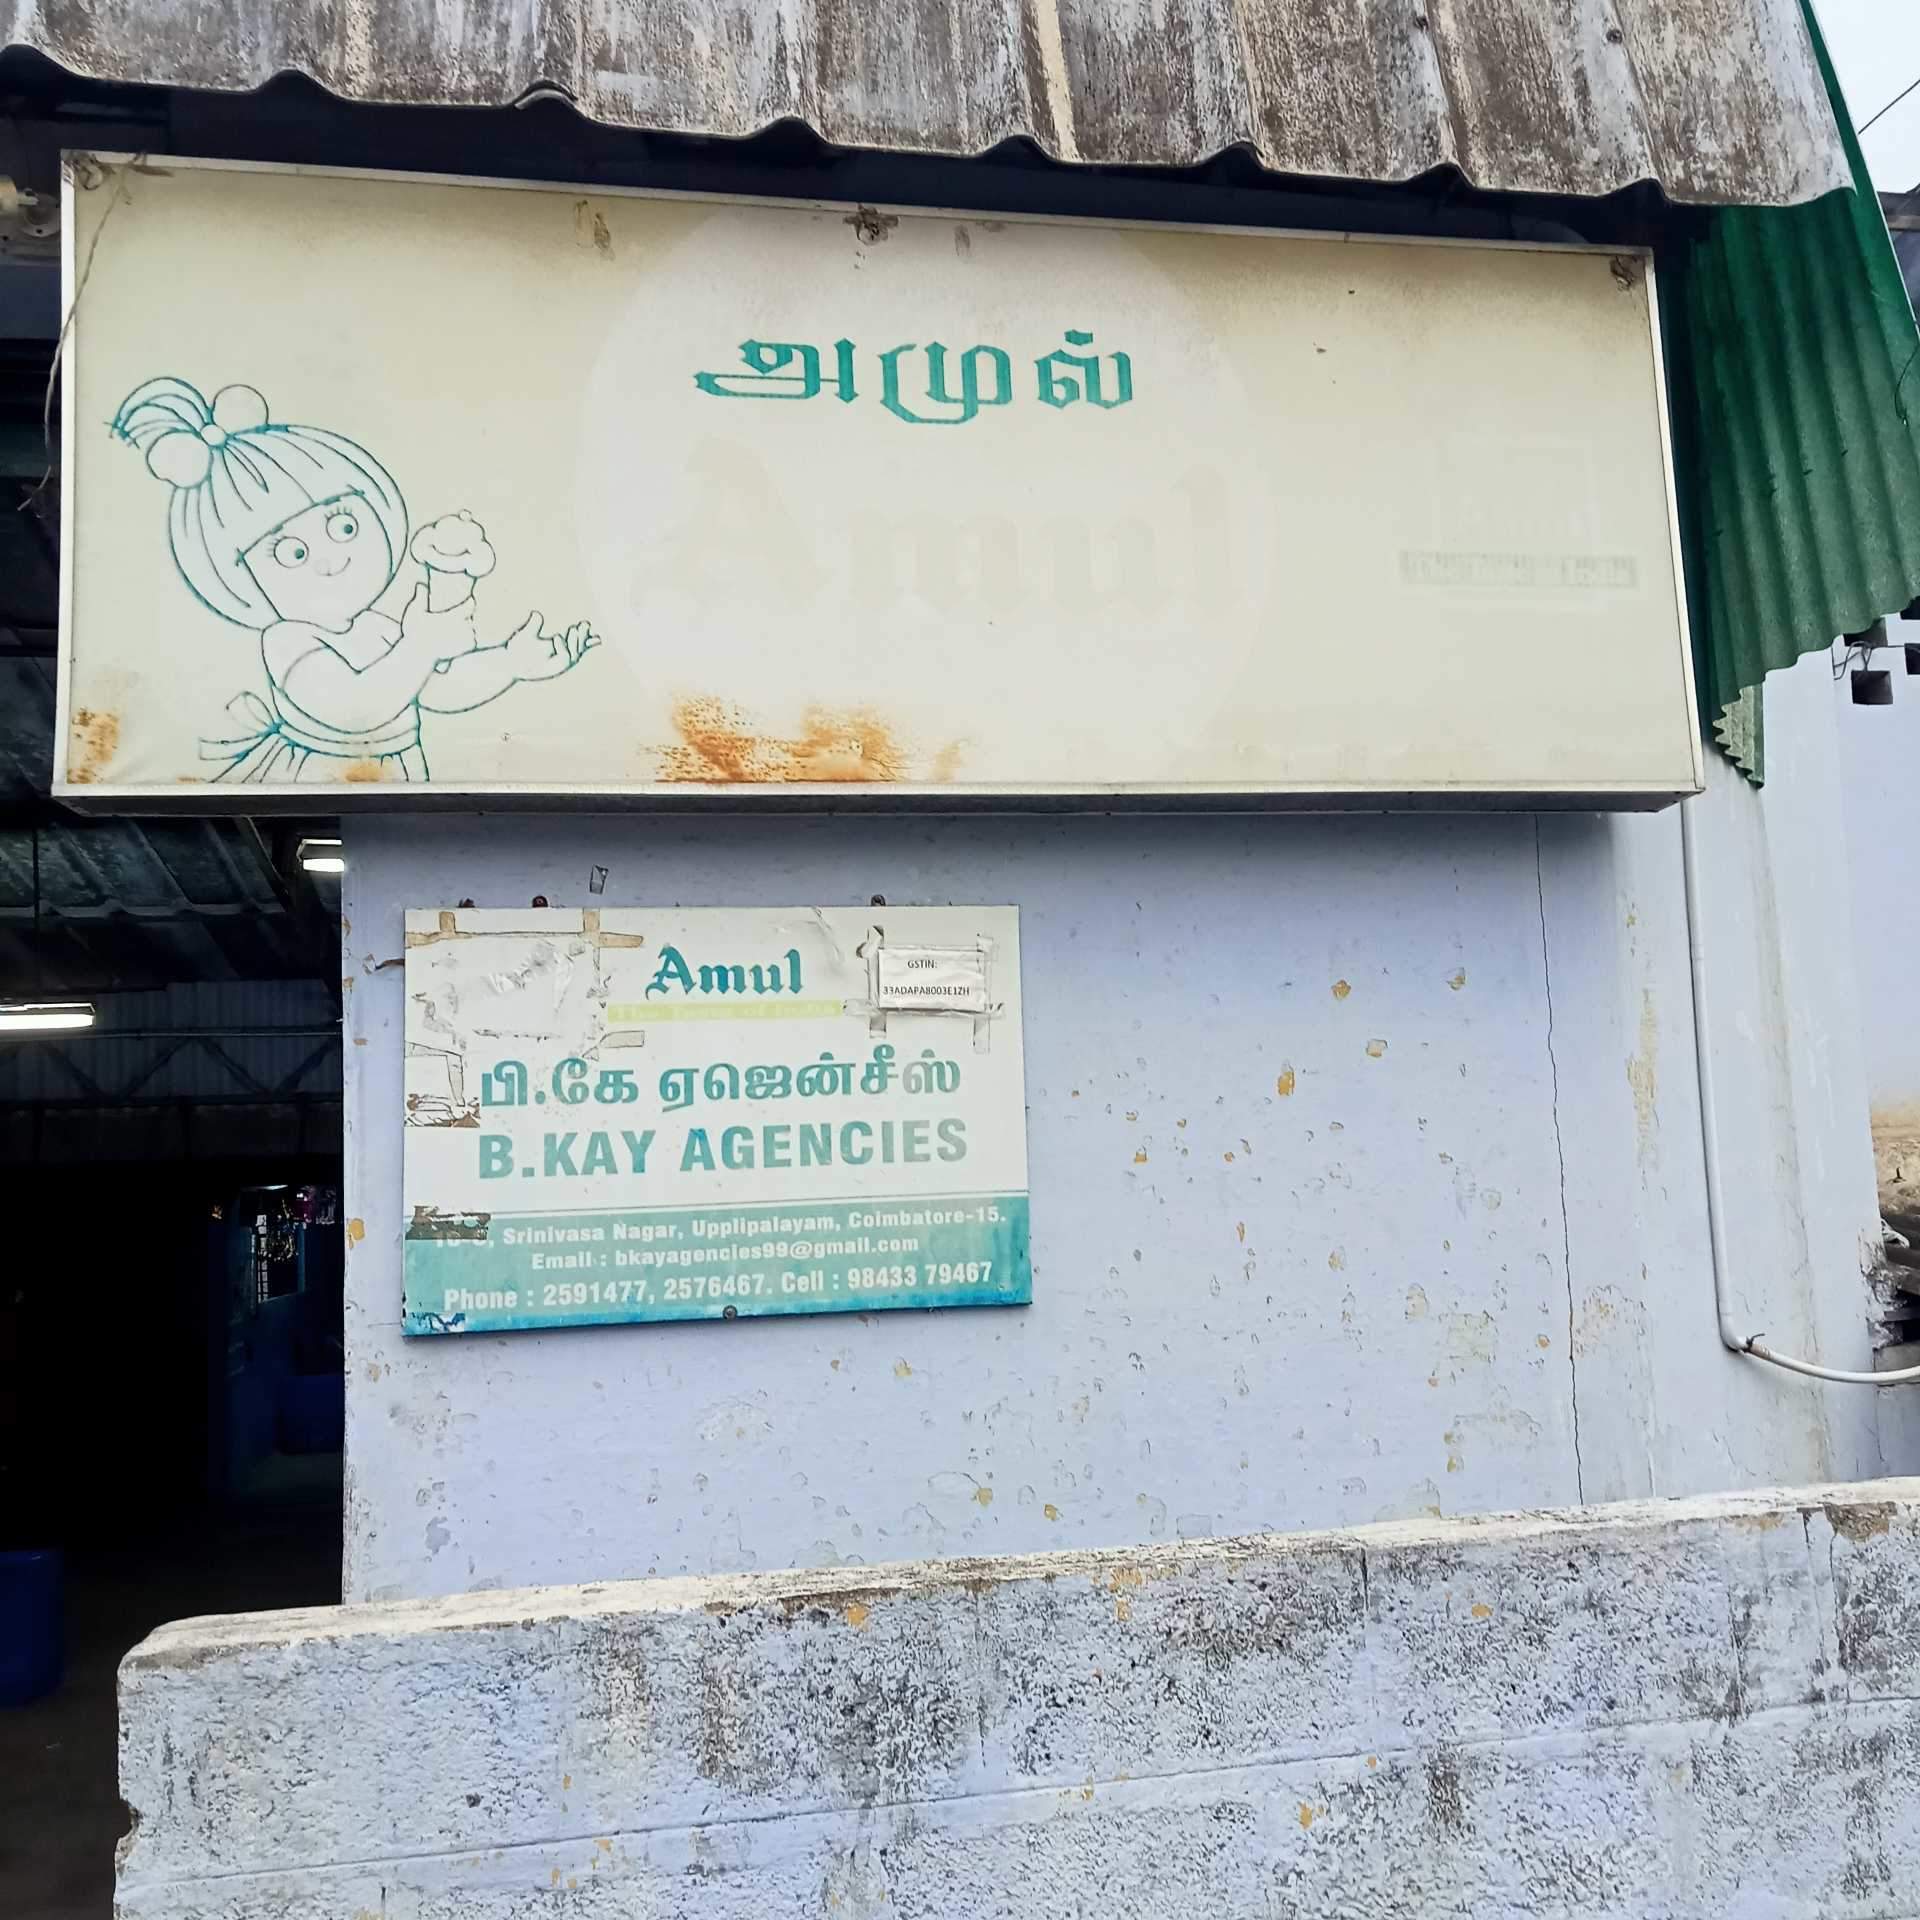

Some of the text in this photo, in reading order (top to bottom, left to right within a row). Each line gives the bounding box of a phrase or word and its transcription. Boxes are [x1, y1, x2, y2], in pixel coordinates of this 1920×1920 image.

[693, 329, 1133, 424] அமுல்
[645, 945, 803, 1000] Amul
[907, 959, 938, 969] GSTIN:
[477, 1043, 961, 1113] பி.கே ஏஜென்சீஸ்
[479, 1118, 967, 1179] B.KAY AGENCIES
[503, 1225, 605, 1245] Srinivasa
[613, 1221, 684, 1243] Nagar,
[691, 1214, 841, 1239] Upplipalayam,
[848, 1206, 1006, 1228] Coimbatore-15.
[531, 1251, 592, 1271] Email
[615, 1237, 919, 1268] bkayagencies99@gmail.com
[444, 1288, 518, 1311] Phone
[543, 1279, 656, 1306] 2591477,
[664, 1273, 772, 1299] 2576467.
[781, 1269, 824, 1293] Cell
[847, 1264, 917, 1289] 98433
[925, 1261, 992, 1284] 79467
